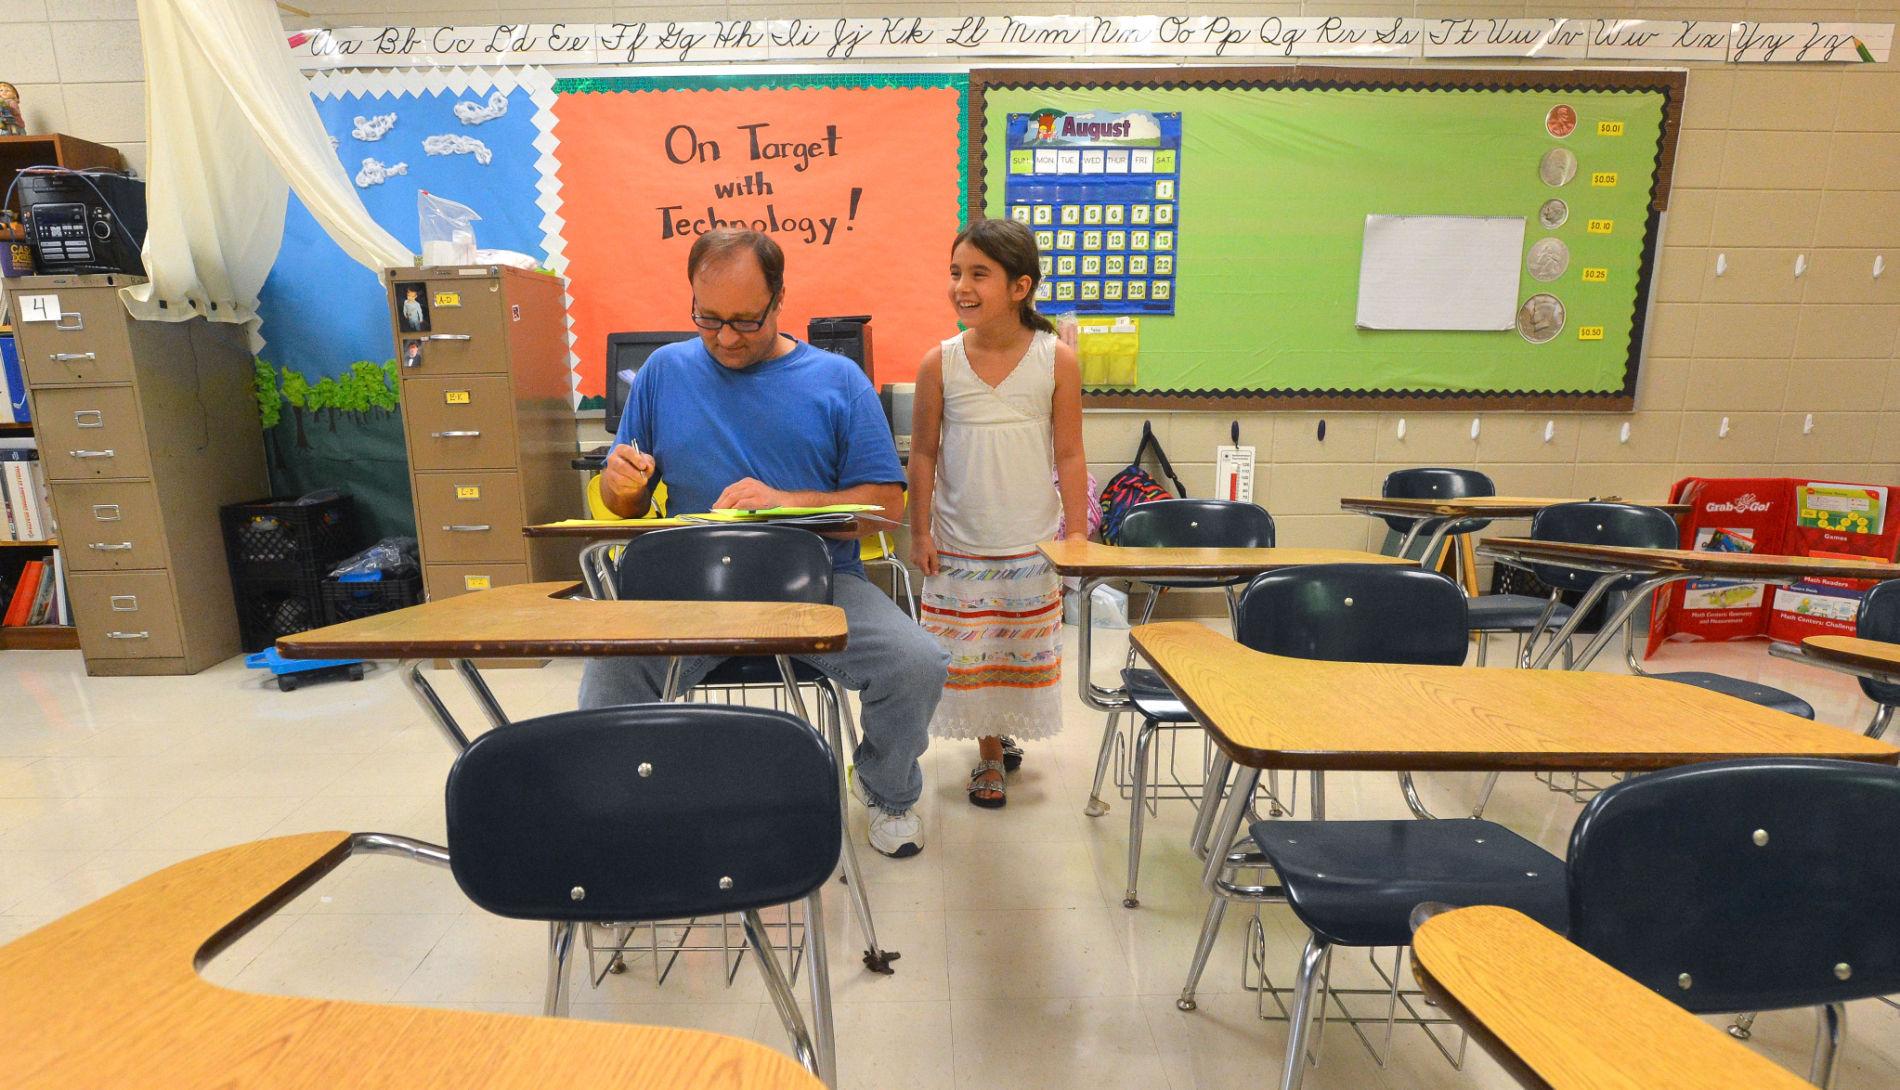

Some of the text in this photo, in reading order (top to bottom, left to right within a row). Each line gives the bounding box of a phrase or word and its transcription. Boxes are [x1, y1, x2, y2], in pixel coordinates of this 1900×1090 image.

[373, 27, 421, 54] Bb
[433, 27, 473, 53] Cc
[484, 24, 537, 51] Dd
[548, 24, 589, 52] Ee
[601, 23, 647, 62] Ff
[658, 22, 706, 62] Gg
[714, 21, 762, 47] Hh
[826, 19, 872, 58] Jj
[880, 18, 935, 44] Kk
[946, 17, 990, 46] Ll
[1001, 16, 1084, 44] Mm
[1159, 17, 1195, 43] Oo
[1200, 17, 1252, 55] Pp
[1260, 18, 1306, 55] Qq
[1316, 17, 1365, 43] Rr
[1373, 18, 1420, 44] Ss
[1429, 19, 1479, 45] Tt
[1487, 19, 1542, 45] Uu
[1597, 19, 1660, 47] Ww
[1672, 20, 1726, 47] Xx
[1735, 22, 1792, 62] Yy
[1796, 22, 1853, 61] Zz
[1062, 116, 1131, 141] August
[1601, 123, 1621, 133] $0.01
[665, 123, 843, 172] On Target
[1594, 175, 1615, 184] $0.05
[715, 171, 774, 199] with
[1164, 185, 1167, 194] 1
[1018, 209, 1166, 220] 2 3 4 5 6 7 8
[1590, 222, 1610, 231] $0.10
[1039, 235, 1168, 245] 10 11 12 13 14 15
[1062, 260, 1071, 270] 18
[1087, 260, 1096, 270] 19
[1109, 260, 1121, 269] 20
[1133, 260, 1143, 269] 21
[1157, 260, 1169, 269] 22
[1585, 270, 1605, 279] $0.25
[1059, 286, 1071, 296] 25
[1084, 286, 1096, 295] 26
[1107, 286, 1119, 295] 27
[1131, 286, 1143, 295] 28
[1155, 286, 1167, 295] 29
[439, 296, 452, 305] A-D
[33, 297, 47, 319] 4
[1581, 327, 1602, 336] $0.50
[1824, 533, 1848, 542] Games
[1804, 576, 1848, 587] Math Readers
[1781, 613, 1796, 621] Math
